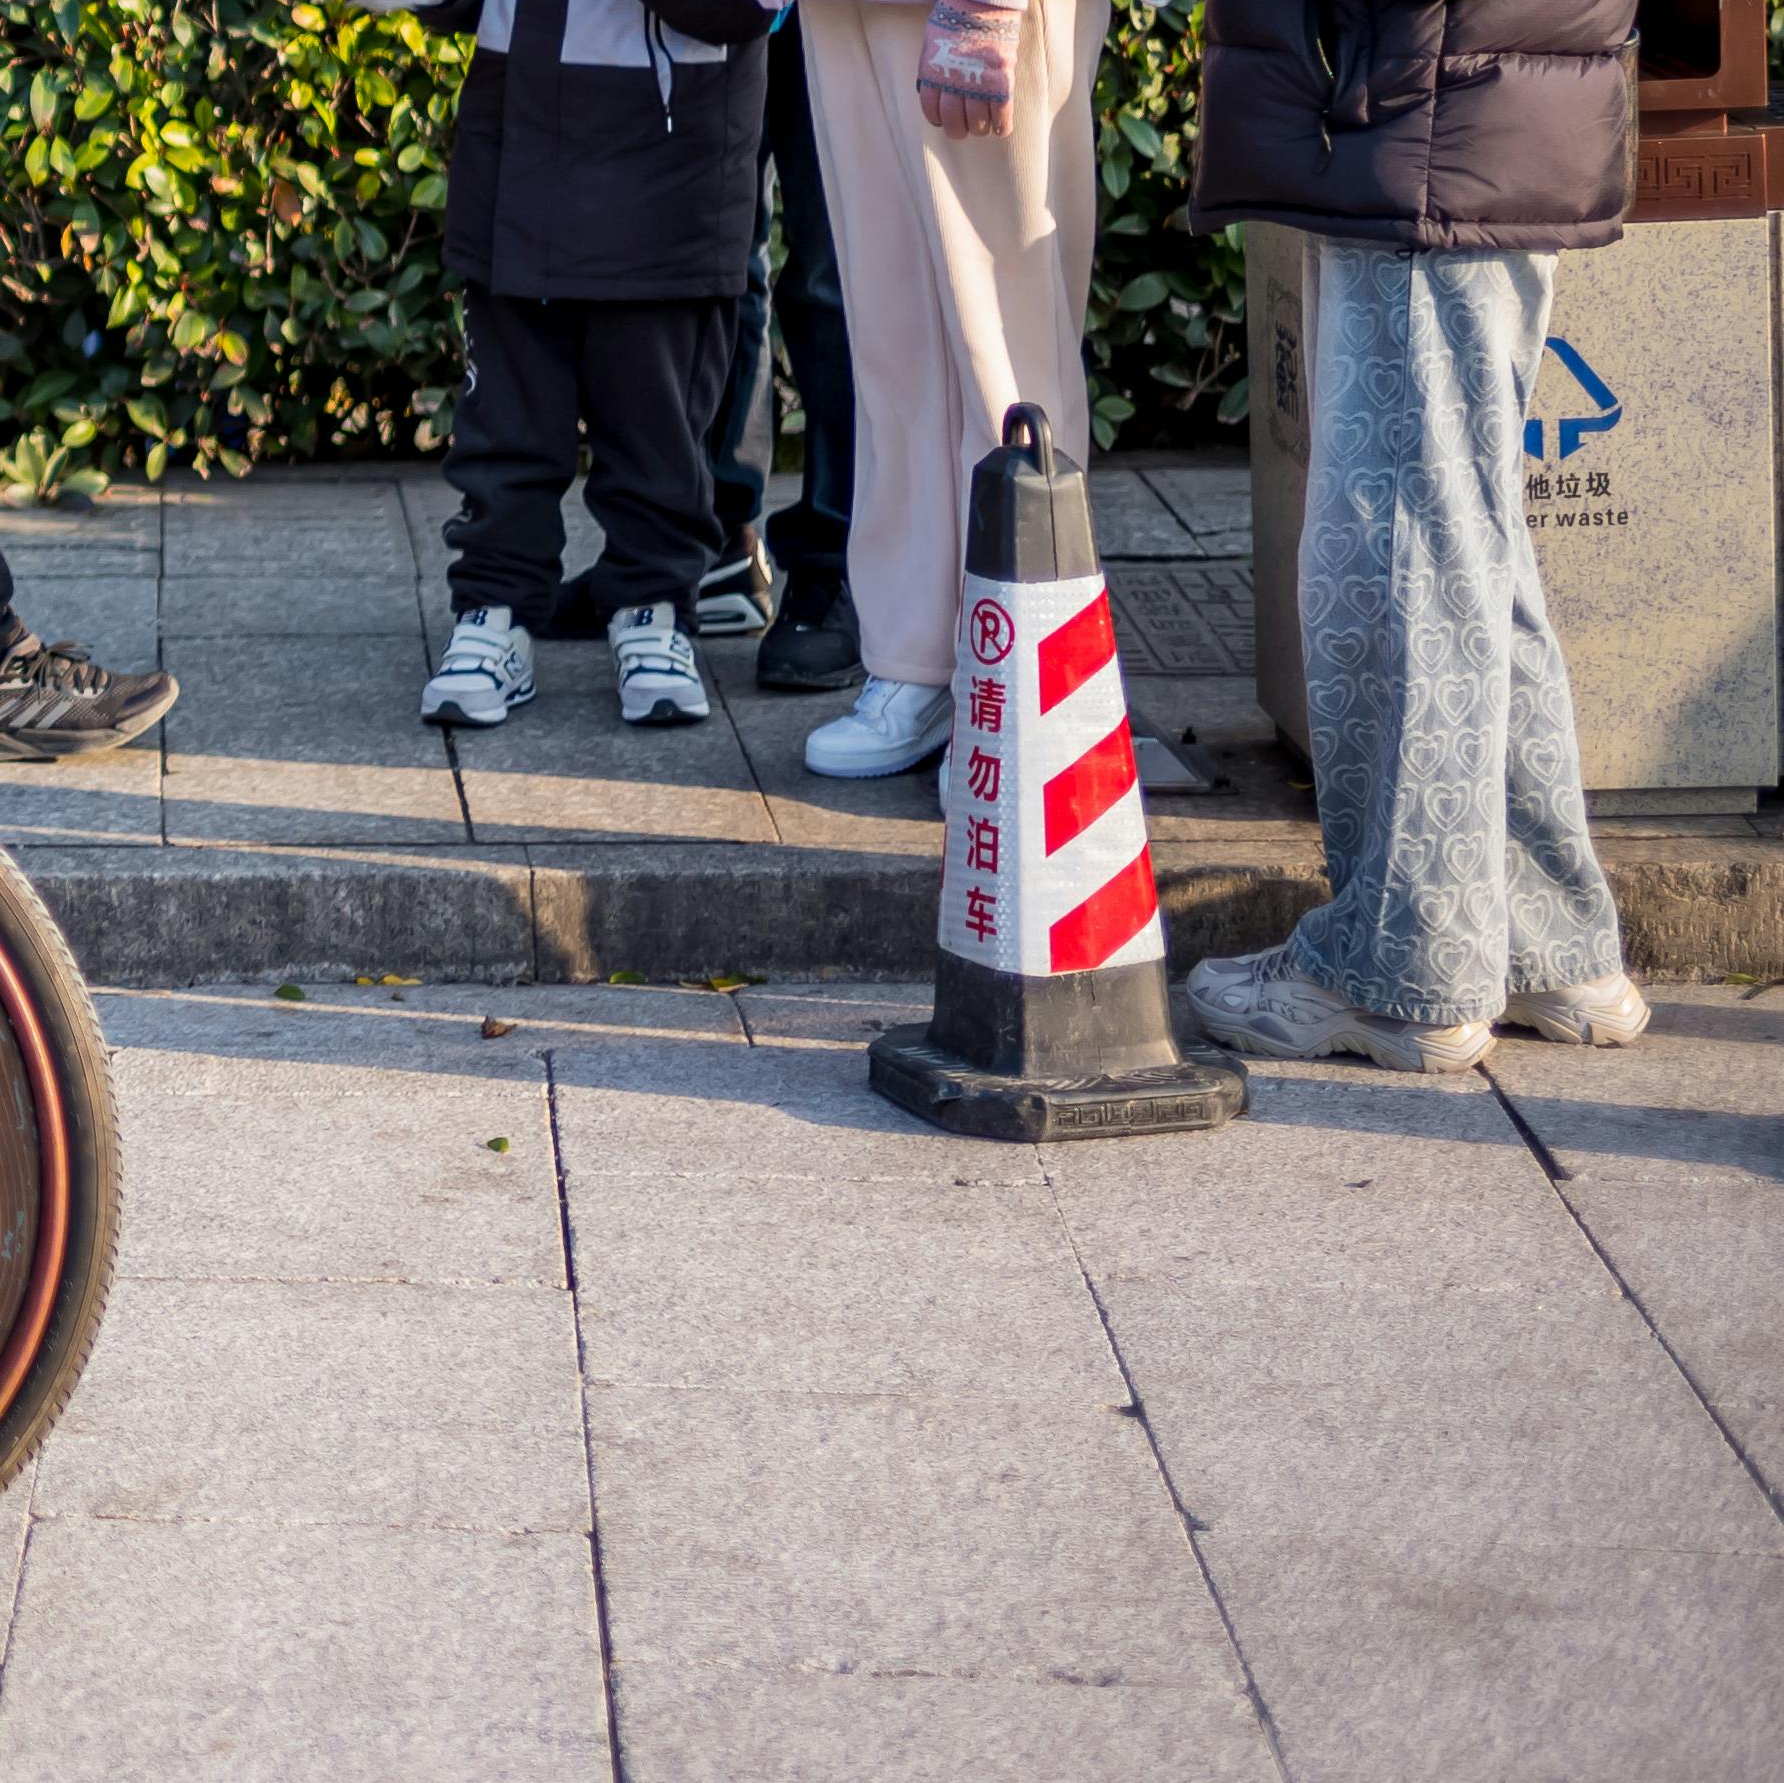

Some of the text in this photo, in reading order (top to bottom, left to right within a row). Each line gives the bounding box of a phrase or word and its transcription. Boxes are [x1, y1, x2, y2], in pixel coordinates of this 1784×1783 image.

[1555, 508, 1629, 527] waste
[965, 675, 1007, 943] 请勿泊车
